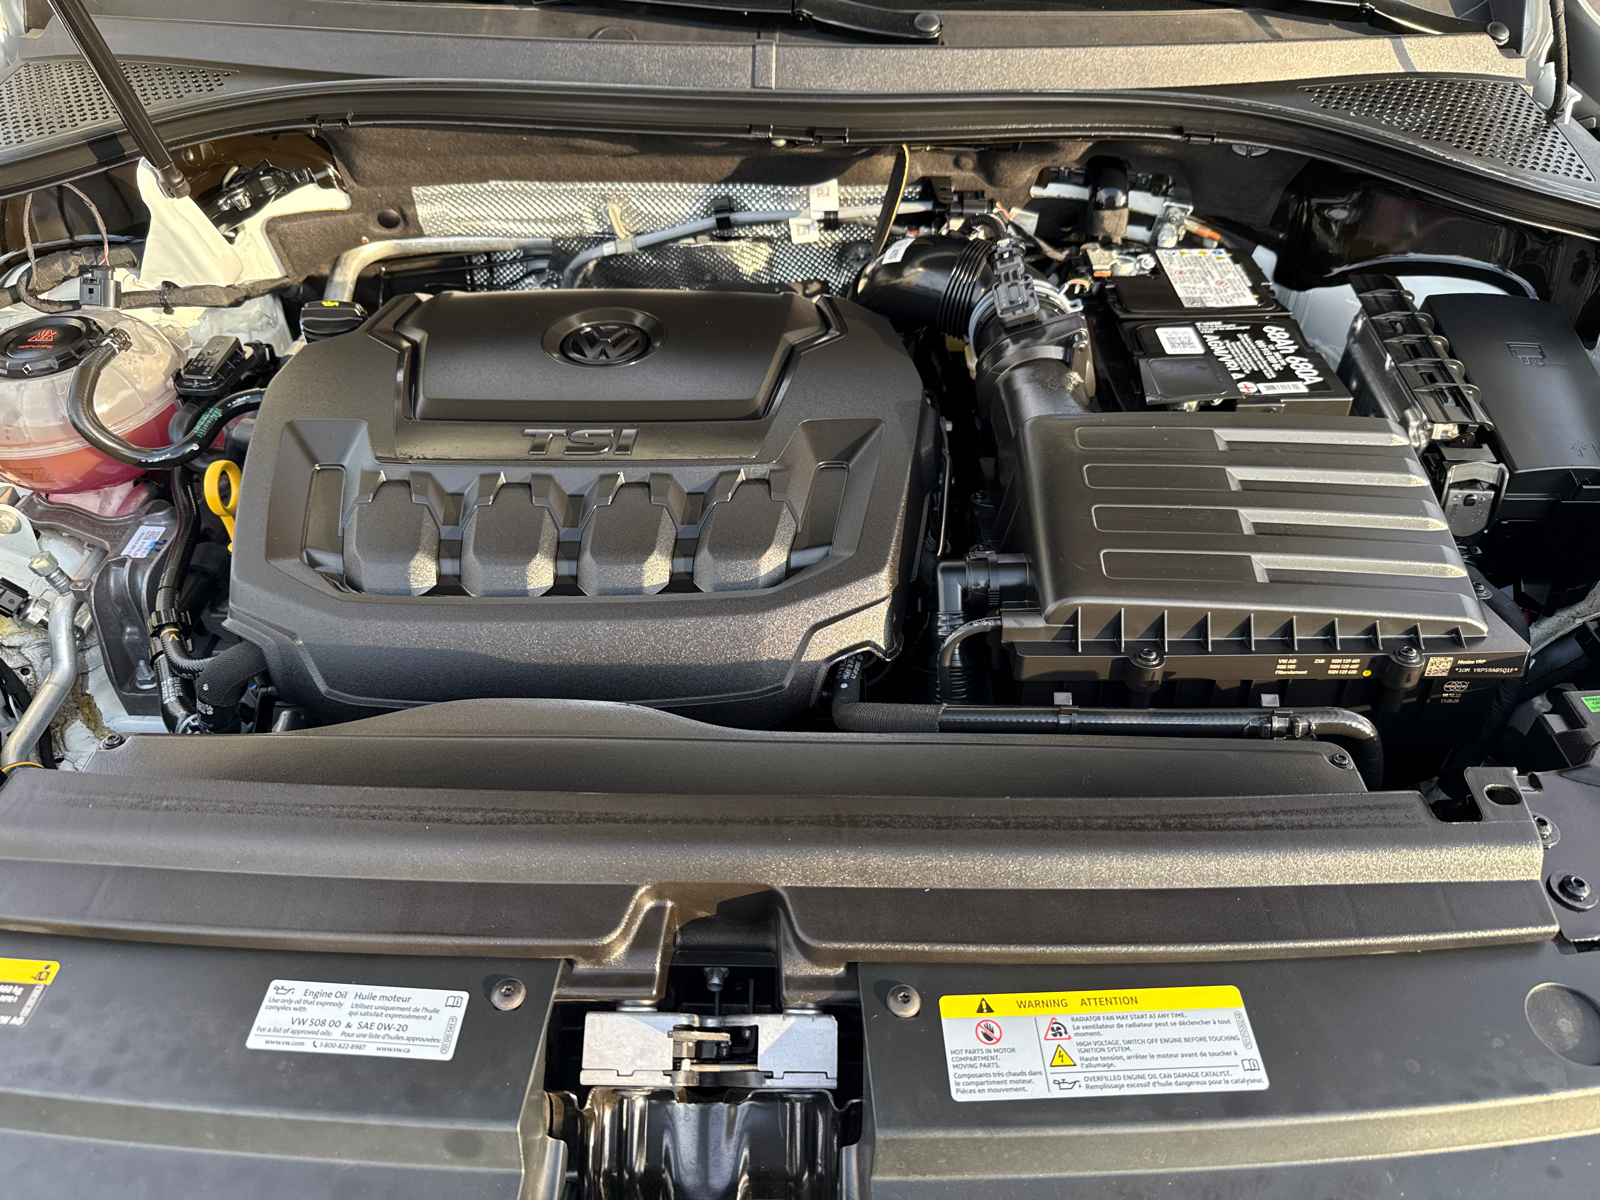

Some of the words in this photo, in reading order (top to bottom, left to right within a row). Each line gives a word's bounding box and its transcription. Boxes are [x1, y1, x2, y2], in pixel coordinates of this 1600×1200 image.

[1262, 325, 1299, 354] 68Ah
[1285, 355, 1324, 385] 680A
[523, 428, 639, 456] TSI
[303, 988, 333, 999] Engine
[334, 991, 348, 999] Oil
[354, 991, 377, 1001] Huile
[378, 994, 412, 1003] moteur
[265, 1004, 291, 1012] complies
[280, 997, 293, 1005] only
[316, 1000, 344, 1008] expressly
[1016, 998, 1068, 1009] WARNING
[1080, 996, 1138, 1007] ATTENTION
[374, 1004, 411, 1013] uniquement
[421, 1006, 440, 1014] l'huile
[359, 1010, 384, 1018] satisfait
[384, 1012, 427, 1021] expressément
[291, 1017, 308, 1026] VW
[308, 1018, 327, 1027] 508
[328, 1019, 342, 1028] 00
[357, 1021, 376, 1030] SAE
[377, 1022, 408, 1032] 0W-20
[290, 1028, 319, 1036] approved
[340, 1030, 355, 1038] Pour
[382, 1033, 404, 1041] d'huiles
[405, 1035, 441, 1043] approuvées:
[376, 1045, 410, 1053] www.vw.ca
[1208, 1049, 1232, 1057] toucher
[1080, 1061, 1116, 1069] l'allumage.
[962, 1079, 1008, 1087] compartiment
[1083, 1074, 1122, 1082] OVERFILLED
[1085, 1082, 1125, 1090] Remplissage
[1230, 1077, 1265, 1085] catalyseur.
